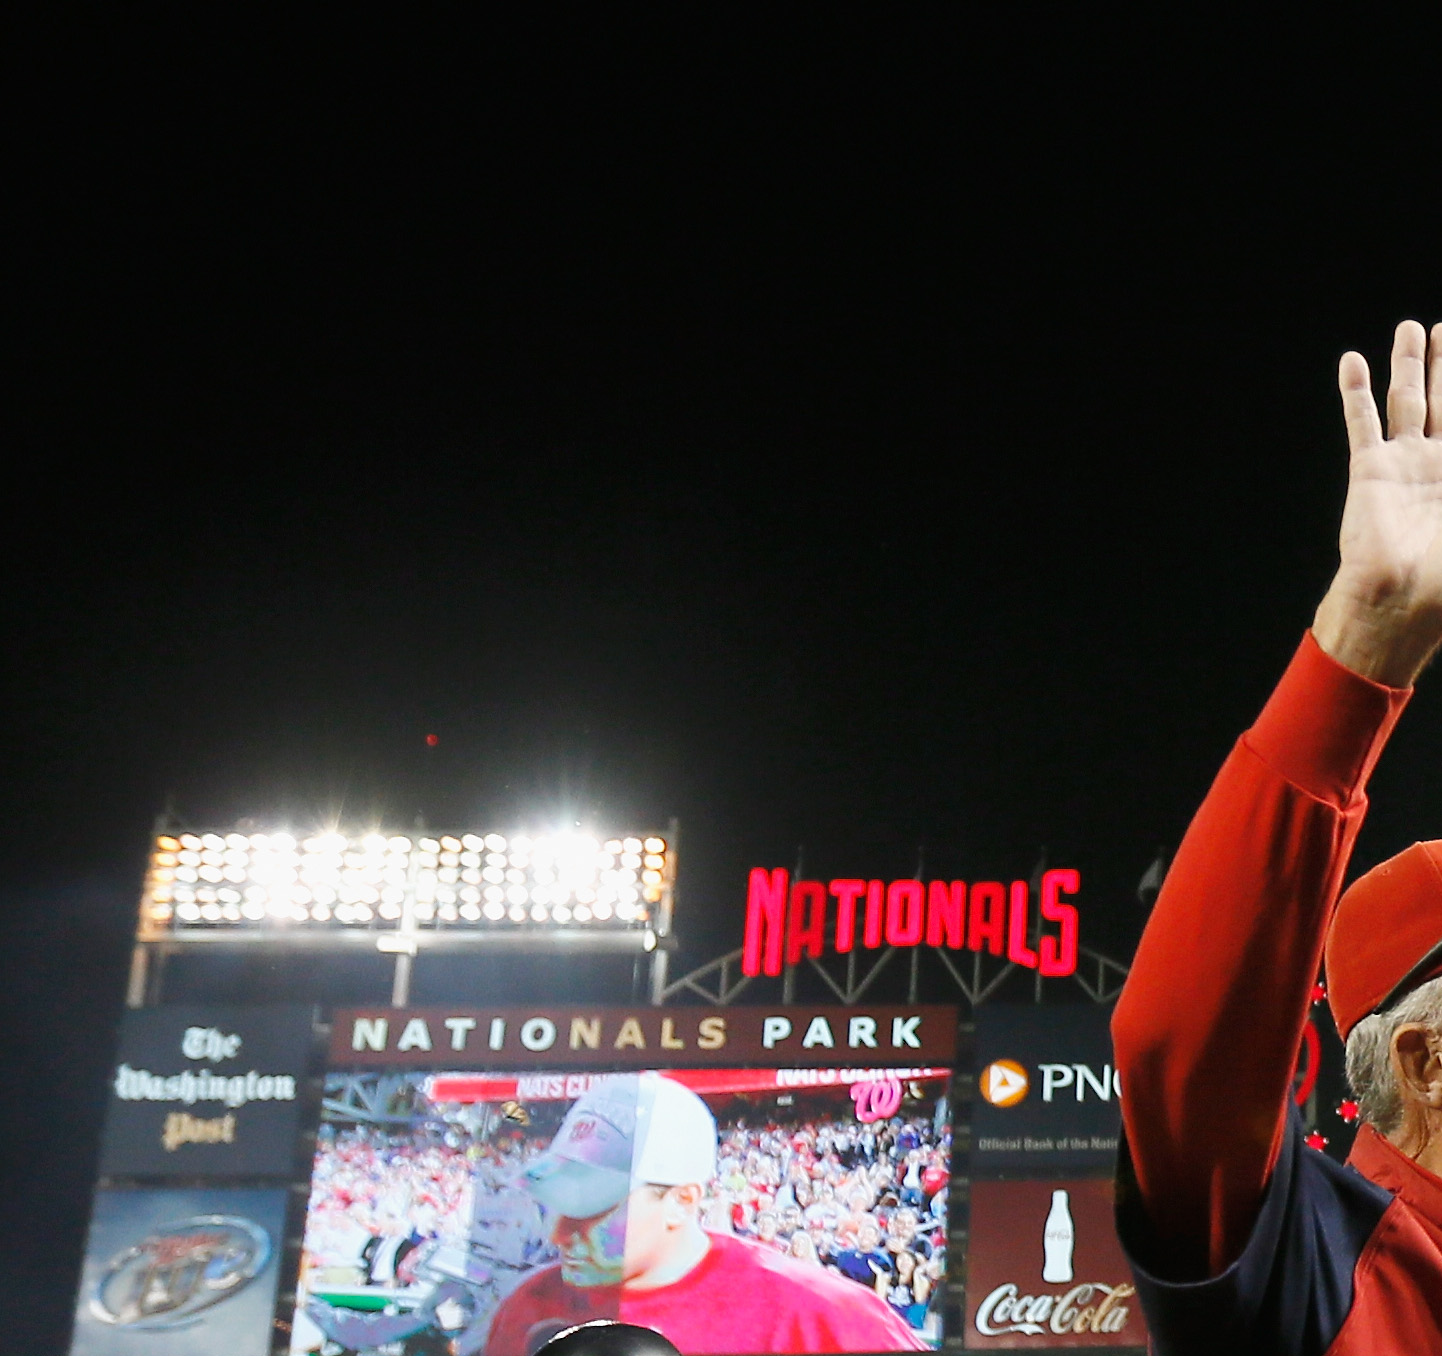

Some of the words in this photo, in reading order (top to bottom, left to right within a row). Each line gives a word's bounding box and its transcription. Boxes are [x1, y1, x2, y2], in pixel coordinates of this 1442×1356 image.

[742, 867, 1080, 977] NATIONALS
[182, 1026, 242, 1063] The
[352, 1016, 727, 1050] NATIONALS
[762, 1016, 923, 1049] PARK
[114, 1063, 297, 1108] Washington
[1038, 1062, 1121, 1102] PN
[162, 1112, 237, 1152] Post
[975, 1282, 1136, 1336] Coca-Cola
